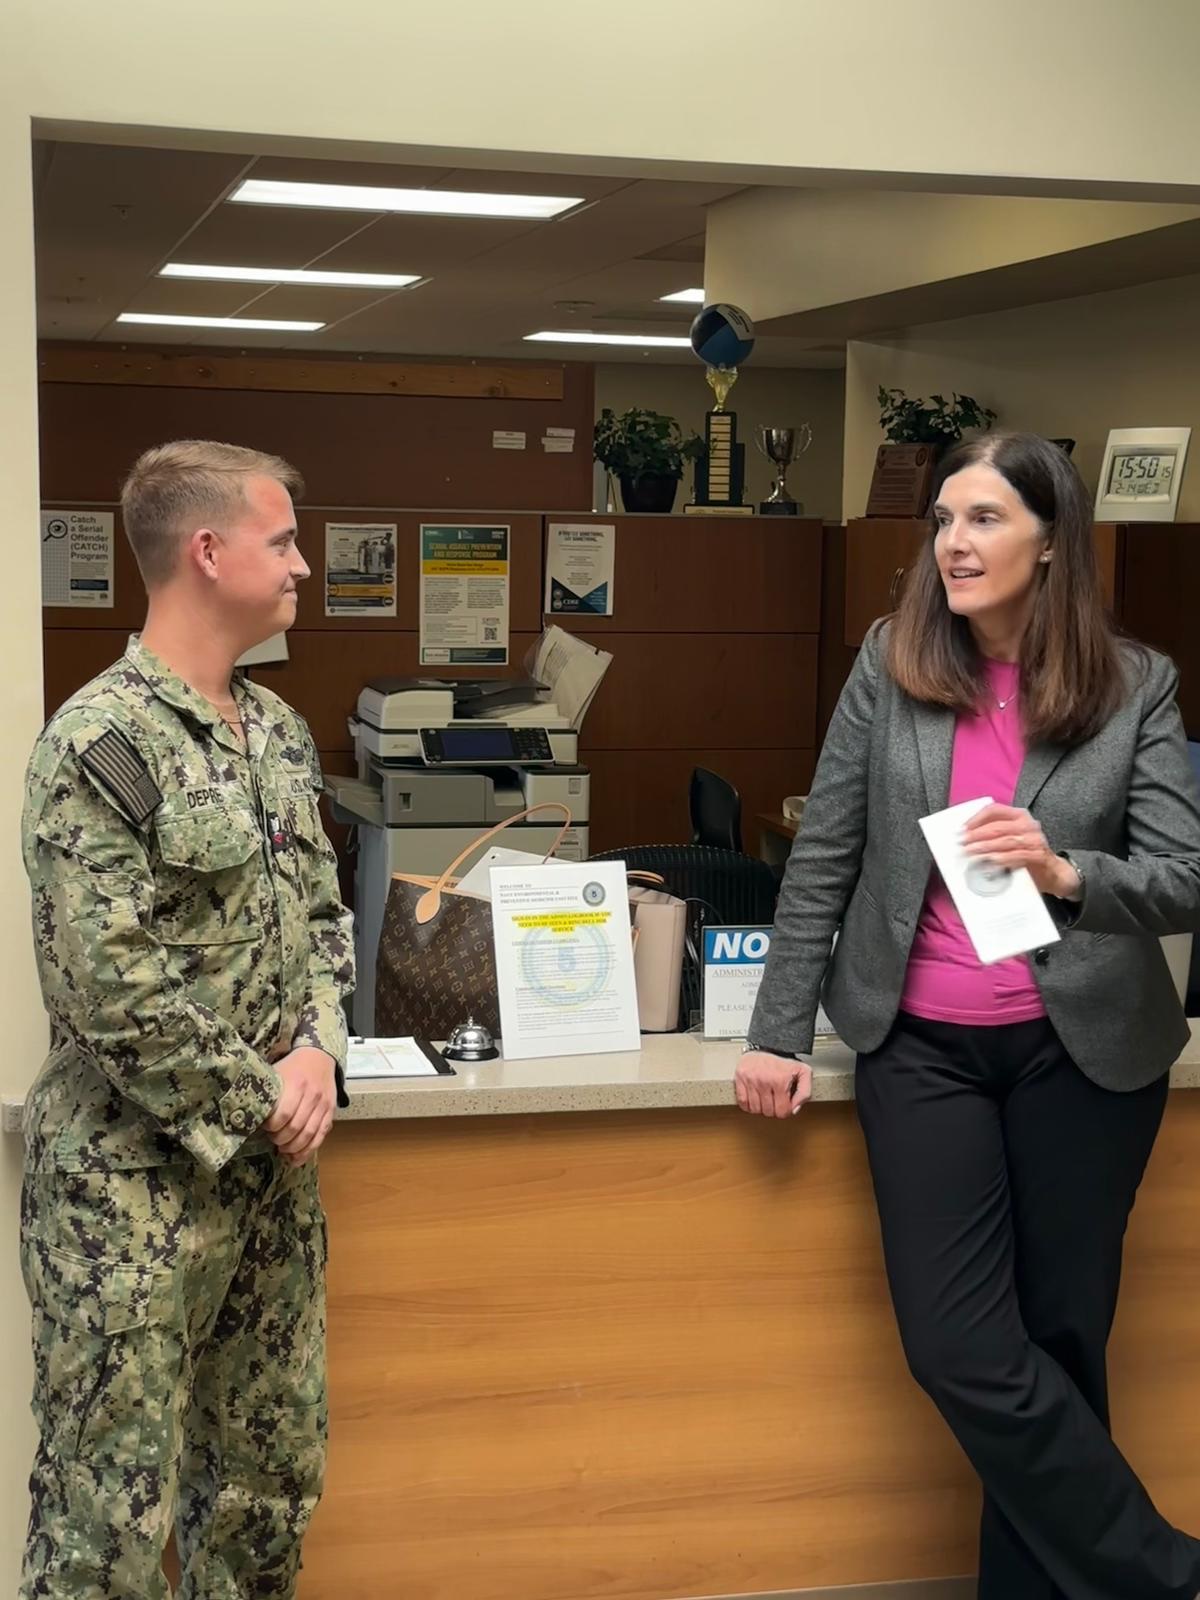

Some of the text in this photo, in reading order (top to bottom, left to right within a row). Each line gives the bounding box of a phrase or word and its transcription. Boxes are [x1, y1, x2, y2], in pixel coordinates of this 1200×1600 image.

[1119, 457, 1160, 479] 15:50
[70, 515, 97, 523] Catch
[78, 524, 104, 532] Serial
[70, 533, 109, 541] Offender
[70, 542, 109, 552] (CATCH)
[70, 552, 109, 561] Program
[712, 932, 770, 959] NO
